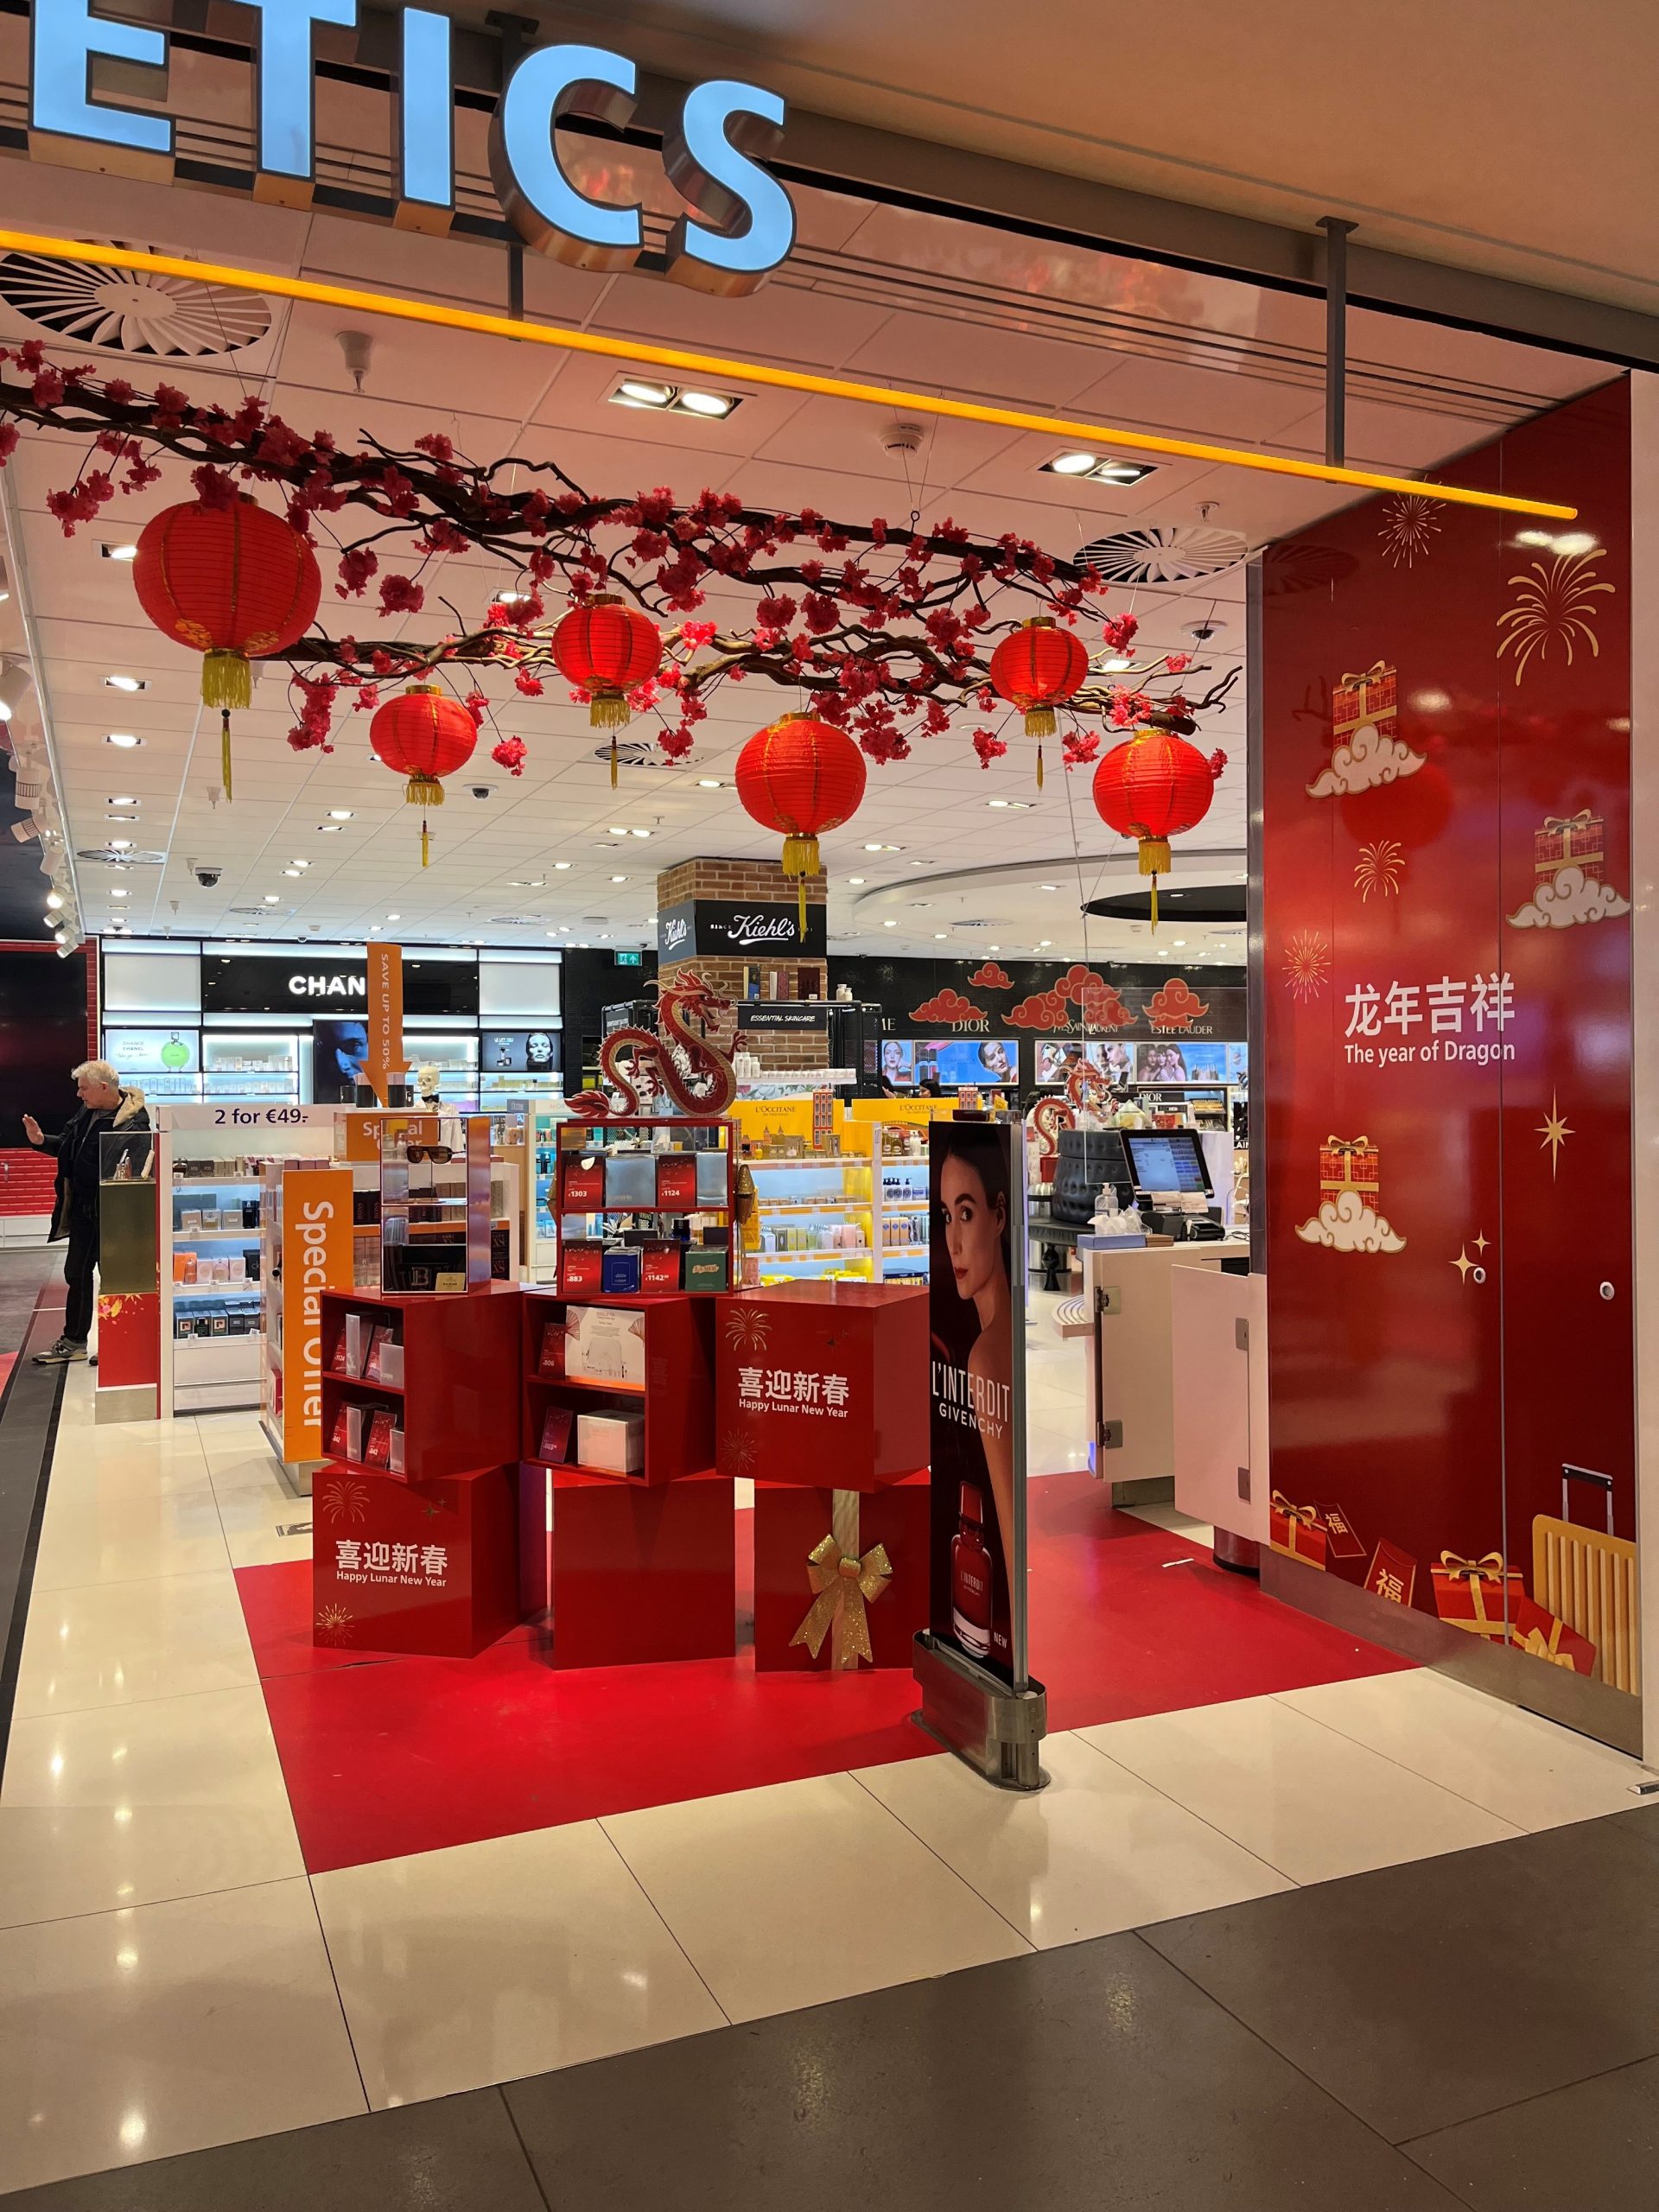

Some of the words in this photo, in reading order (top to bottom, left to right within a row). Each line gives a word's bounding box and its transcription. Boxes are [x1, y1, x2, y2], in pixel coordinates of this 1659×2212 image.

[728, 914, 795, 939] Kiehl's
[288, 975, 365, 996] CHAN
[382, 994, 389, 1012] UP
[1344, 971, 1516, 1039] 龙年吉祥
[382, 1017, 390, 1034] TO
[951, 1019, 990, 1033] DIOR
[382, 1040, 391, 1070] 50%
[1344, 1043, 1374, 1065] The
[1377, 1046, 1416, 1068] year
[1420, 1039, 1440, 1062] of
[1444, 1040, 1516, 1066] Dragon
[214, 1109, 226, 1125] 2
[232, 1108, 260, 1124] for
[738, 1366, 849, 1407] 喜迎新春
[932, 1361, 1010, 1422] L'INTERDIT
[739, 1399, 770, 1413] Happy
[772, 1402, 799, 1413] Lunar
[801, 1404, 824, 1415] New
[826, 1407, 849, 1418] Year
[938, 1402, 1003, 1440] GIVENCHY
[1325, 1512, 1349, 1535] 福
[335, 1539, 448, 1576] 喜迎新春
[336, 1571, 368, 1584] Happy
[370, 1573, 398, 1584] Lunar
[400, 1575, 423, 1586] New
[425, 1577, 447, 1587] Year
[994, 1630, 1007, 1649] NEW
